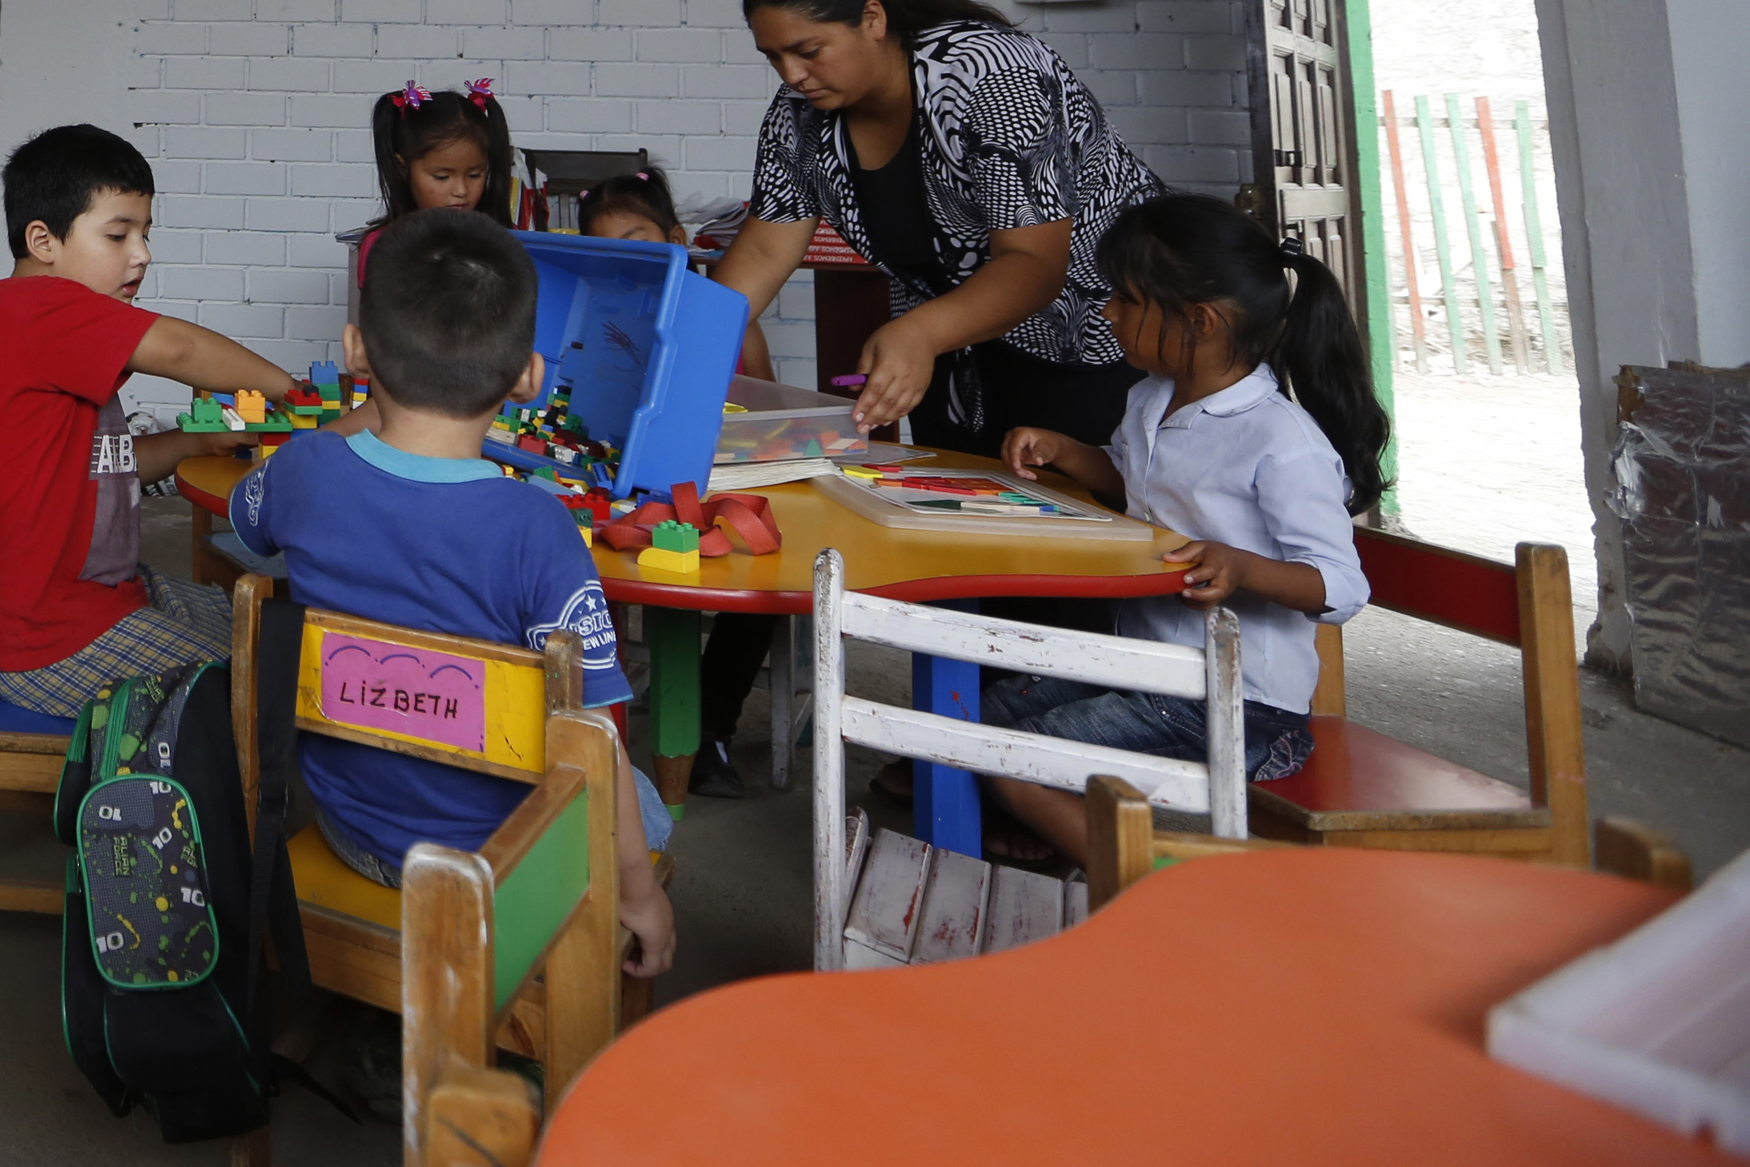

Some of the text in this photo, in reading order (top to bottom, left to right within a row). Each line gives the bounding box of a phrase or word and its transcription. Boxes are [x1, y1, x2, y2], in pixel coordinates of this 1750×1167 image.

[152, 826, 172, 850] 10
[180, 886, 206, 907] 10
[96, 932, 124, 954] 10
